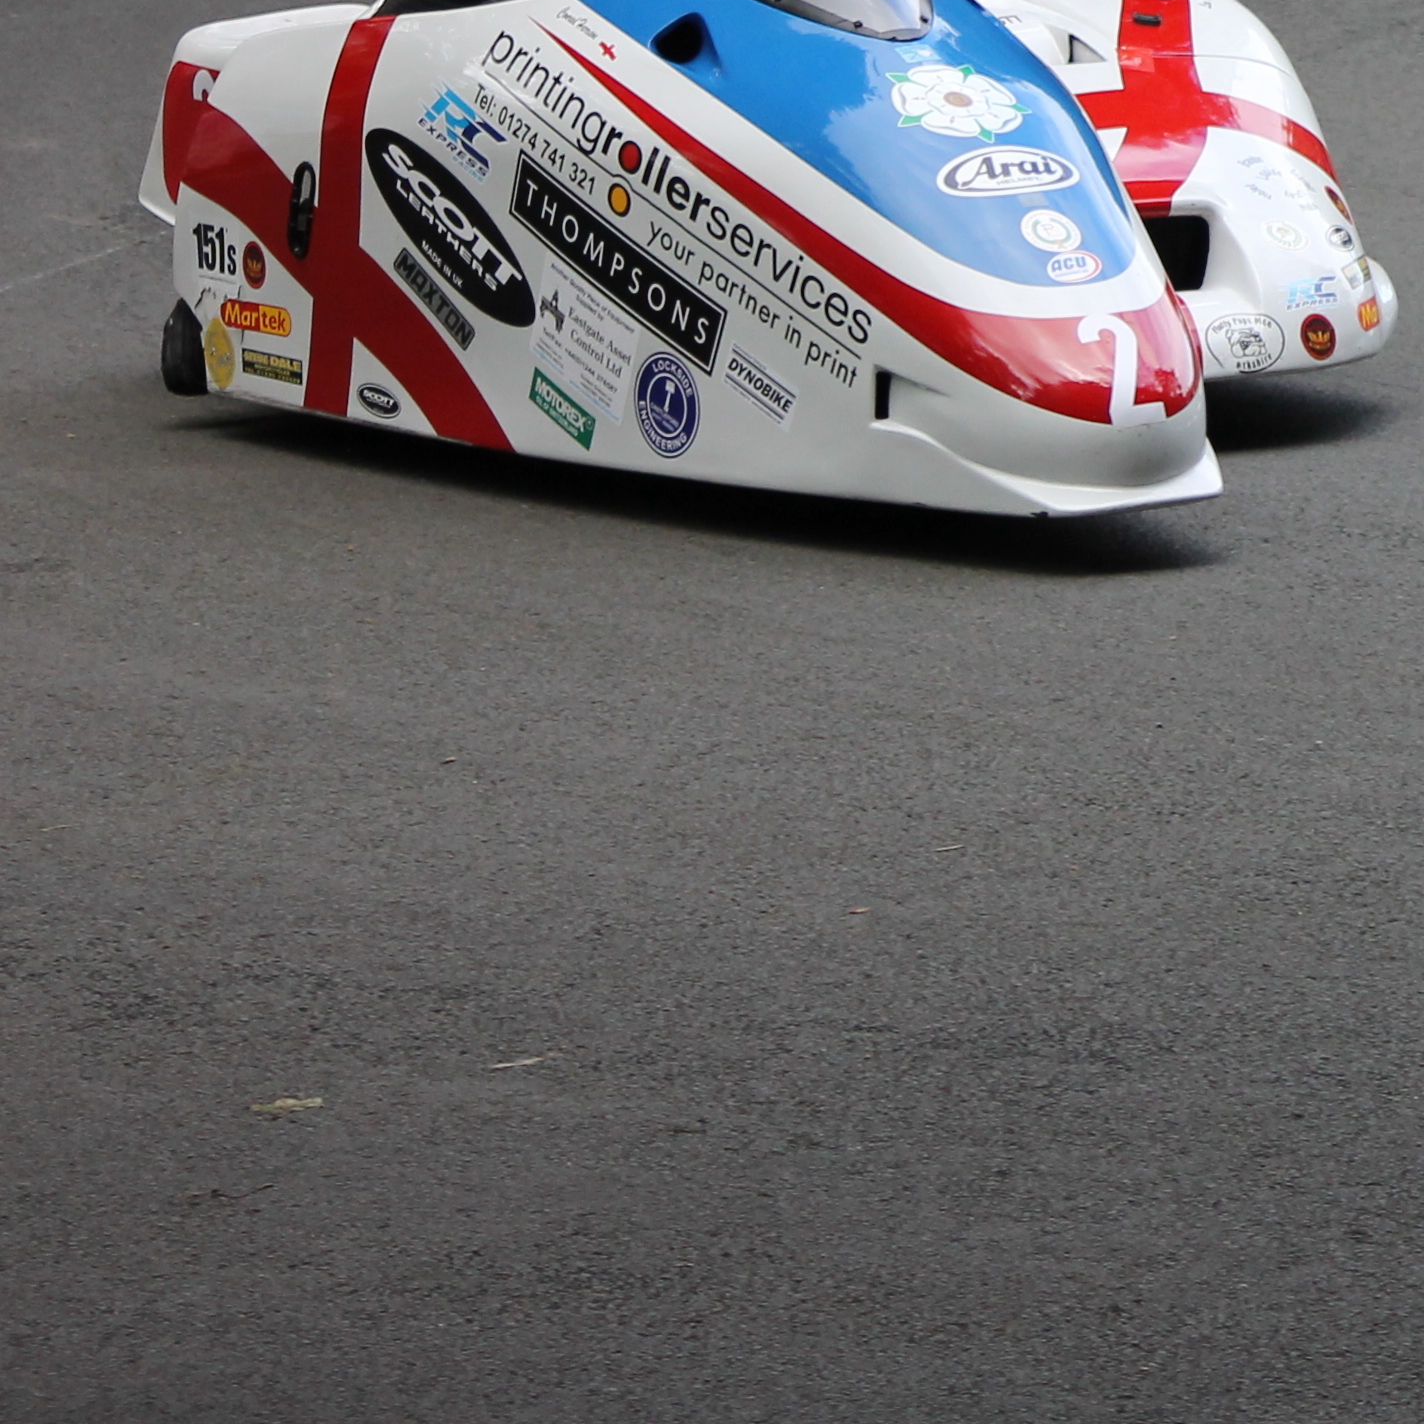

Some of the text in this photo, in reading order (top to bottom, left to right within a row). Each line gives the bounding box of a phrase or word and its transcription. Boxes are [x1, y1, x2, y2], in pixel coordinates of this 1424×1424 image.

[417, 116, 490, 177] EXPRESS
[474, 82, 596, 196] Tel: 01274 741 321
[481, 29, 873, 345] printingrollerservices
[956, 155, 1058, 189] Arai
[382, 143, 523, 286] SCOTT
[396, 179, 498, 291] LEATHERS
[421, 239, 464, 289] MADE IN UK
[525, 178, 710, 345] THOMPSONS
[1051, 255, 1087, 274] ACU
[224, 301, 288, 333] Martek
[396, 252, 474, 346] MAXTON
[648, 220, 695, 267] your
[697, 261, 781, 329] partner
[784, 315, 802, 349] in
[804, 336, 858, 389] print
[568, 305, 632, 367] Eastgate Asset
[570, 329, 605, 365] Control
[606, 357, 623, 379] Ltd
[652, 358, 693, 398] LOCKSIDE
[727, 357, 794, 414] DYNOBIKE
[1076, 312, 1168, 426] 2
[534, 376, 587, 433] MOTOREX
[638, 400, 688, 451] ENGINEERING
